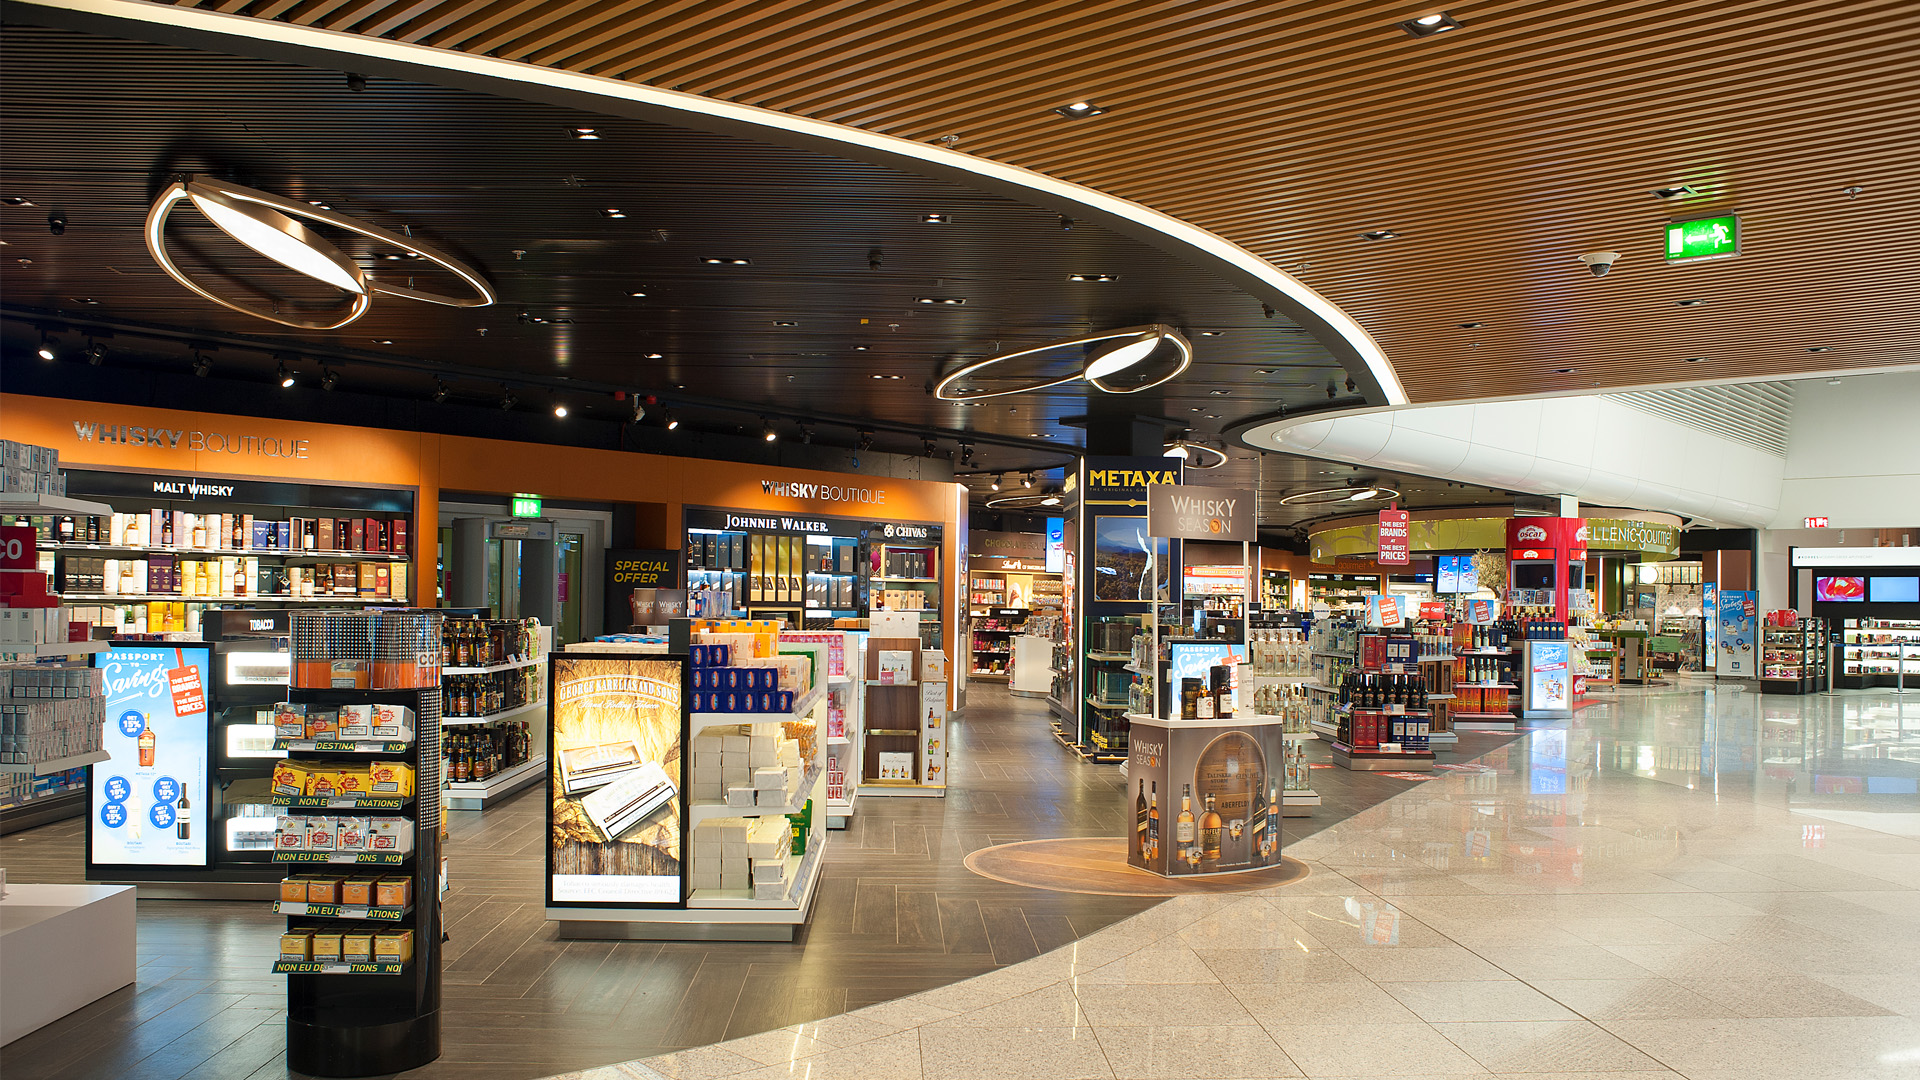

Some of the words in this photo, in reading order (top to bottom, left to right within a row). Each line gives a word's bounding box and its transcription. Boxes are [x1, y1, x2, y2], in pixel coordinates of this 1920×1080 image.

[73, 421, 183, 449] WHISKY
[189, 432, 309, 459] BOUTIQUE
[1089, 470, 1174, 487] METAXA
[154, 481, 186, 493] MALT
[187, 483, 234, 497] WHISKY
[762, 480, 818, 499] WHISKY
[821, 485, 885, 504] BOUTIQUE
[1170, 495, 1236, 517] WHISKY
[725, 514, 777, 529] JOHNNIE
[781, 517, 828, 532] WALKER
[1178, 517, 1231, 533] SEASON
[895, 526, 927, 538] CHIVAS
[1380, 528, 1407, 537] BRANDS
[1519, 530, 1543, 538] oscar
[1587, 527, 1636, 543] ELLENIC
[1380, 551, 1406, 560] PRICES
[614, 561, 670, 572] SPECIAL
[1338, 562, 1366, 571] gourmet
[613, 573, 659, 584] OFFER
[249, 619, 275, 631] TOBACCO
[102, 662, 169, 698] Savings
[171, 680, 200, 694] BRANDS
[560, 681, 595, 700] GEORGE
[596, 678, 637, 691] KARELIAS
[639, 680, 654, 694] AND
[656, 685, 678, 702] SONS
[176, 702, 204, 714] PRICES
[123, 720, 141, 728] 15%
[316, 742, 355, 750] DESTINA
[1134, 739, 1163, 756] WHISKY
[1136, 754, 1160, 767] SEASON
[277, 853, 296, 861] NON
[306, 906, 319, 914] ON
[321, 907, 334, 915] EU
[277, 963, 298, 971] NON
